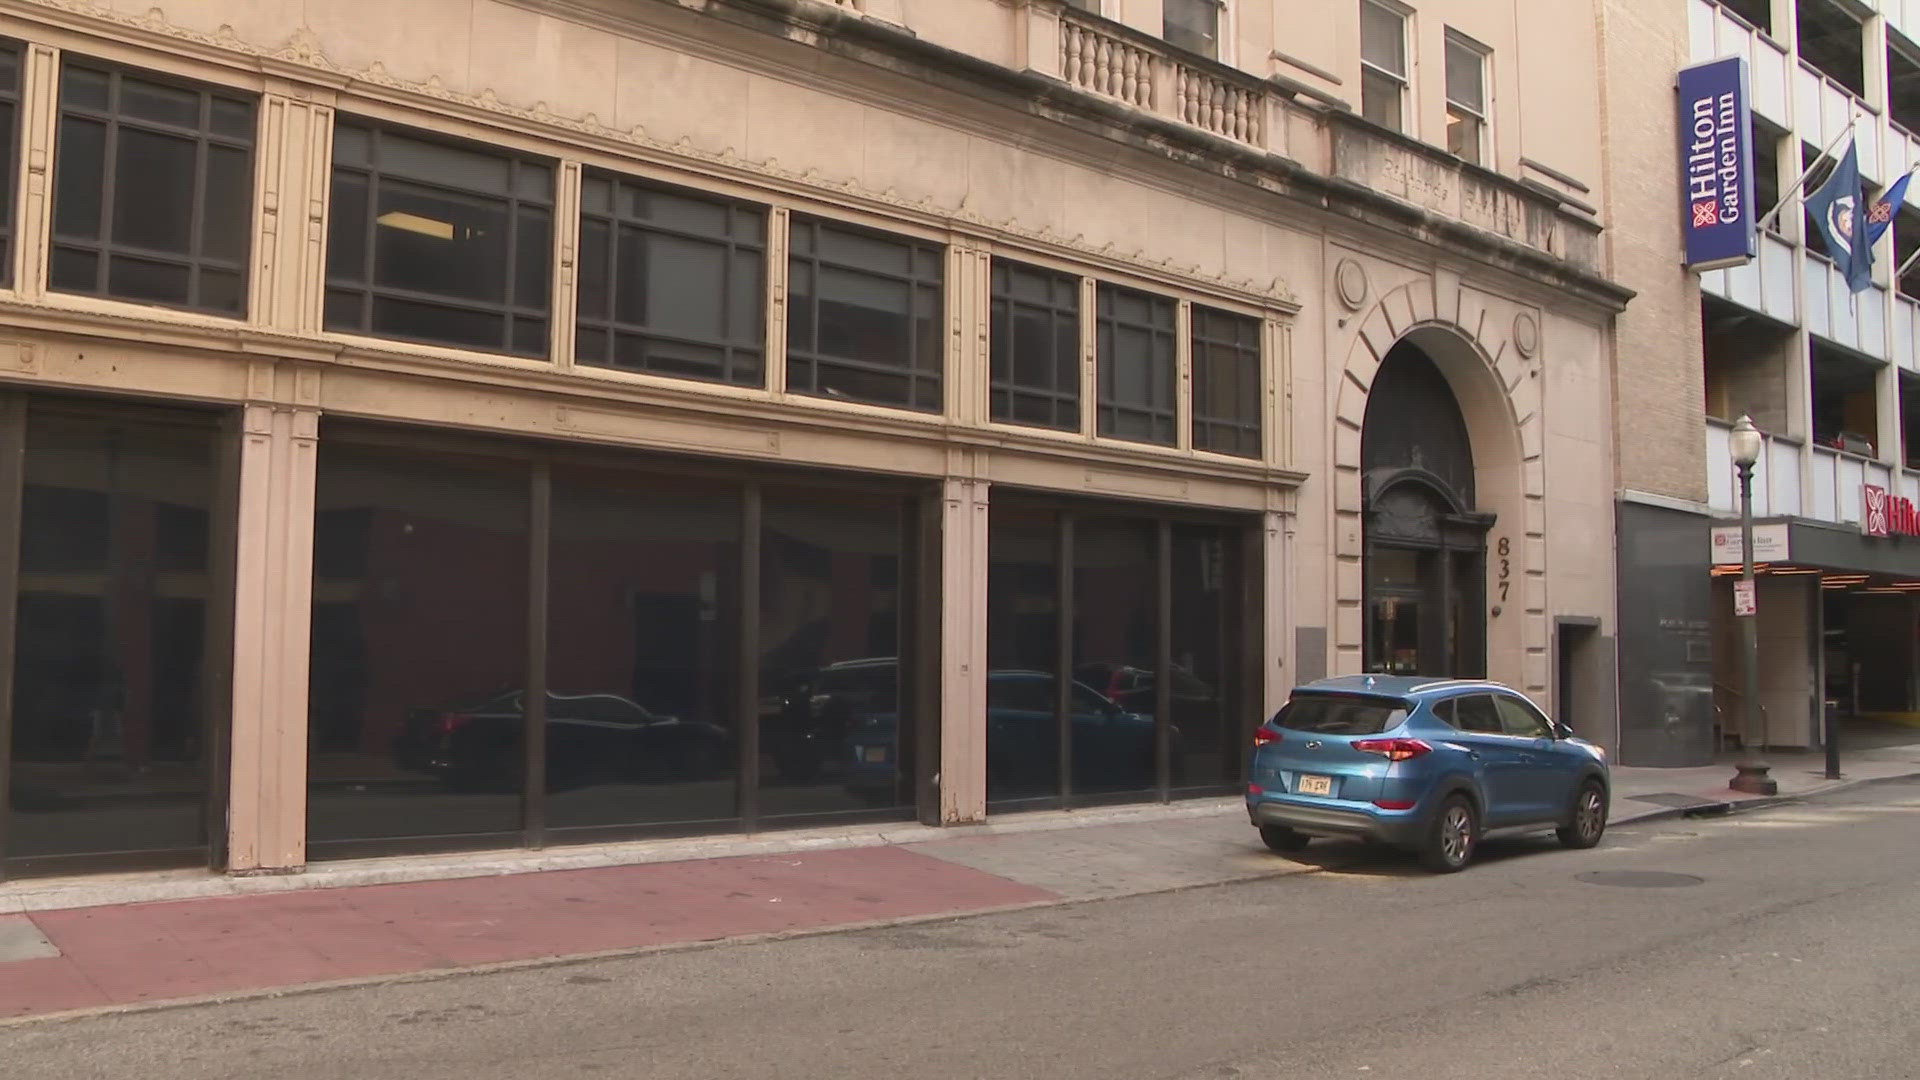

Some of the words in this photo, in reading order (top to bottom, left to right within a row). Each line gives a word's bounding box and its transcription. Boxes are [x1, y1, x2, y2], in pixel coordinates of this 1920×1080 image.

[1690, 96, 1717, 201] Hilton
[1716, 91, 1735, 136] Inn
[1718, 136, 1739, 224] Garden
[1498, 537, 1510, 602] 837
